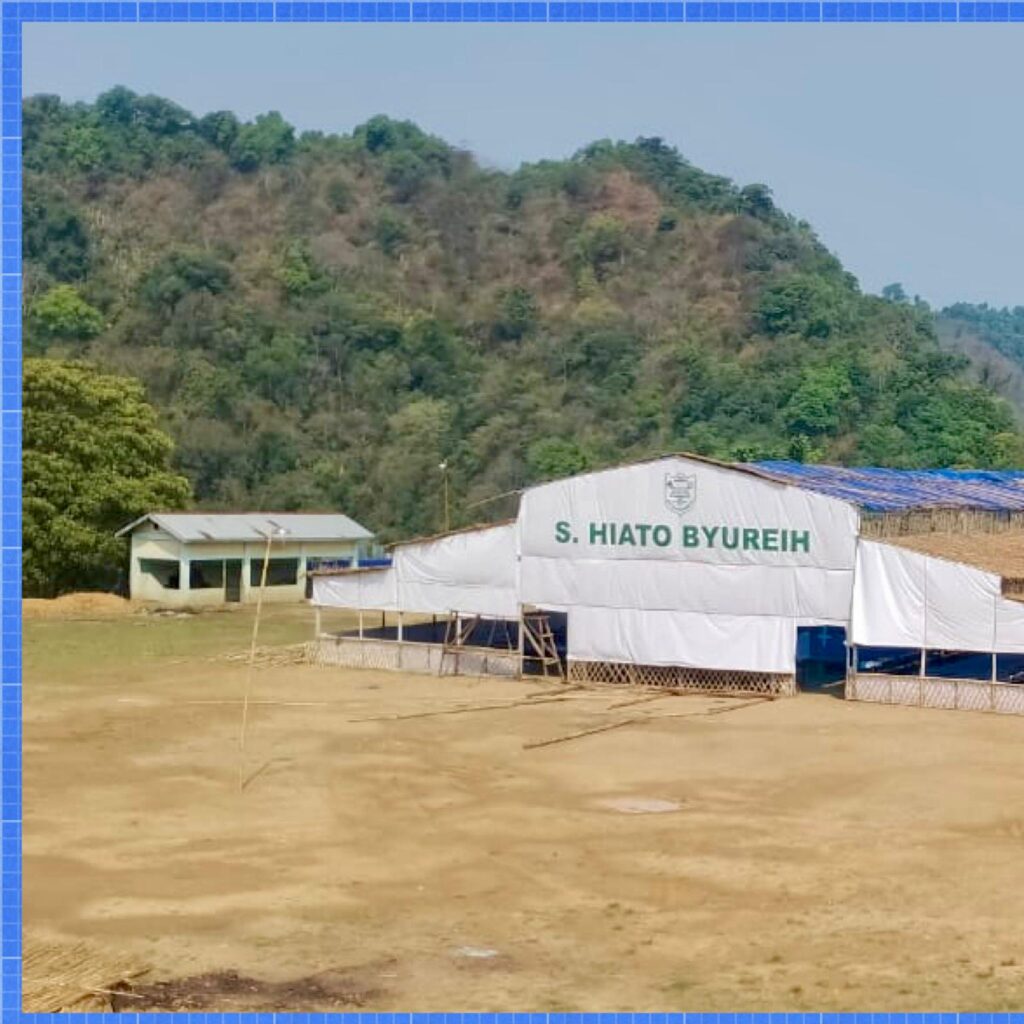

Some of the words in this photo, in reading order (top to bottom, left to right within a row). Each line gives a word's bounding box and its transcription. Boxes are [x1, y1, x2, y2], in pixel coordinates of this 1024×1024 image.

[554, 521, 579, 545] S.
[589, 522, 671, 547] HIATO
[682, 525, 811, 553] BYUREIH
